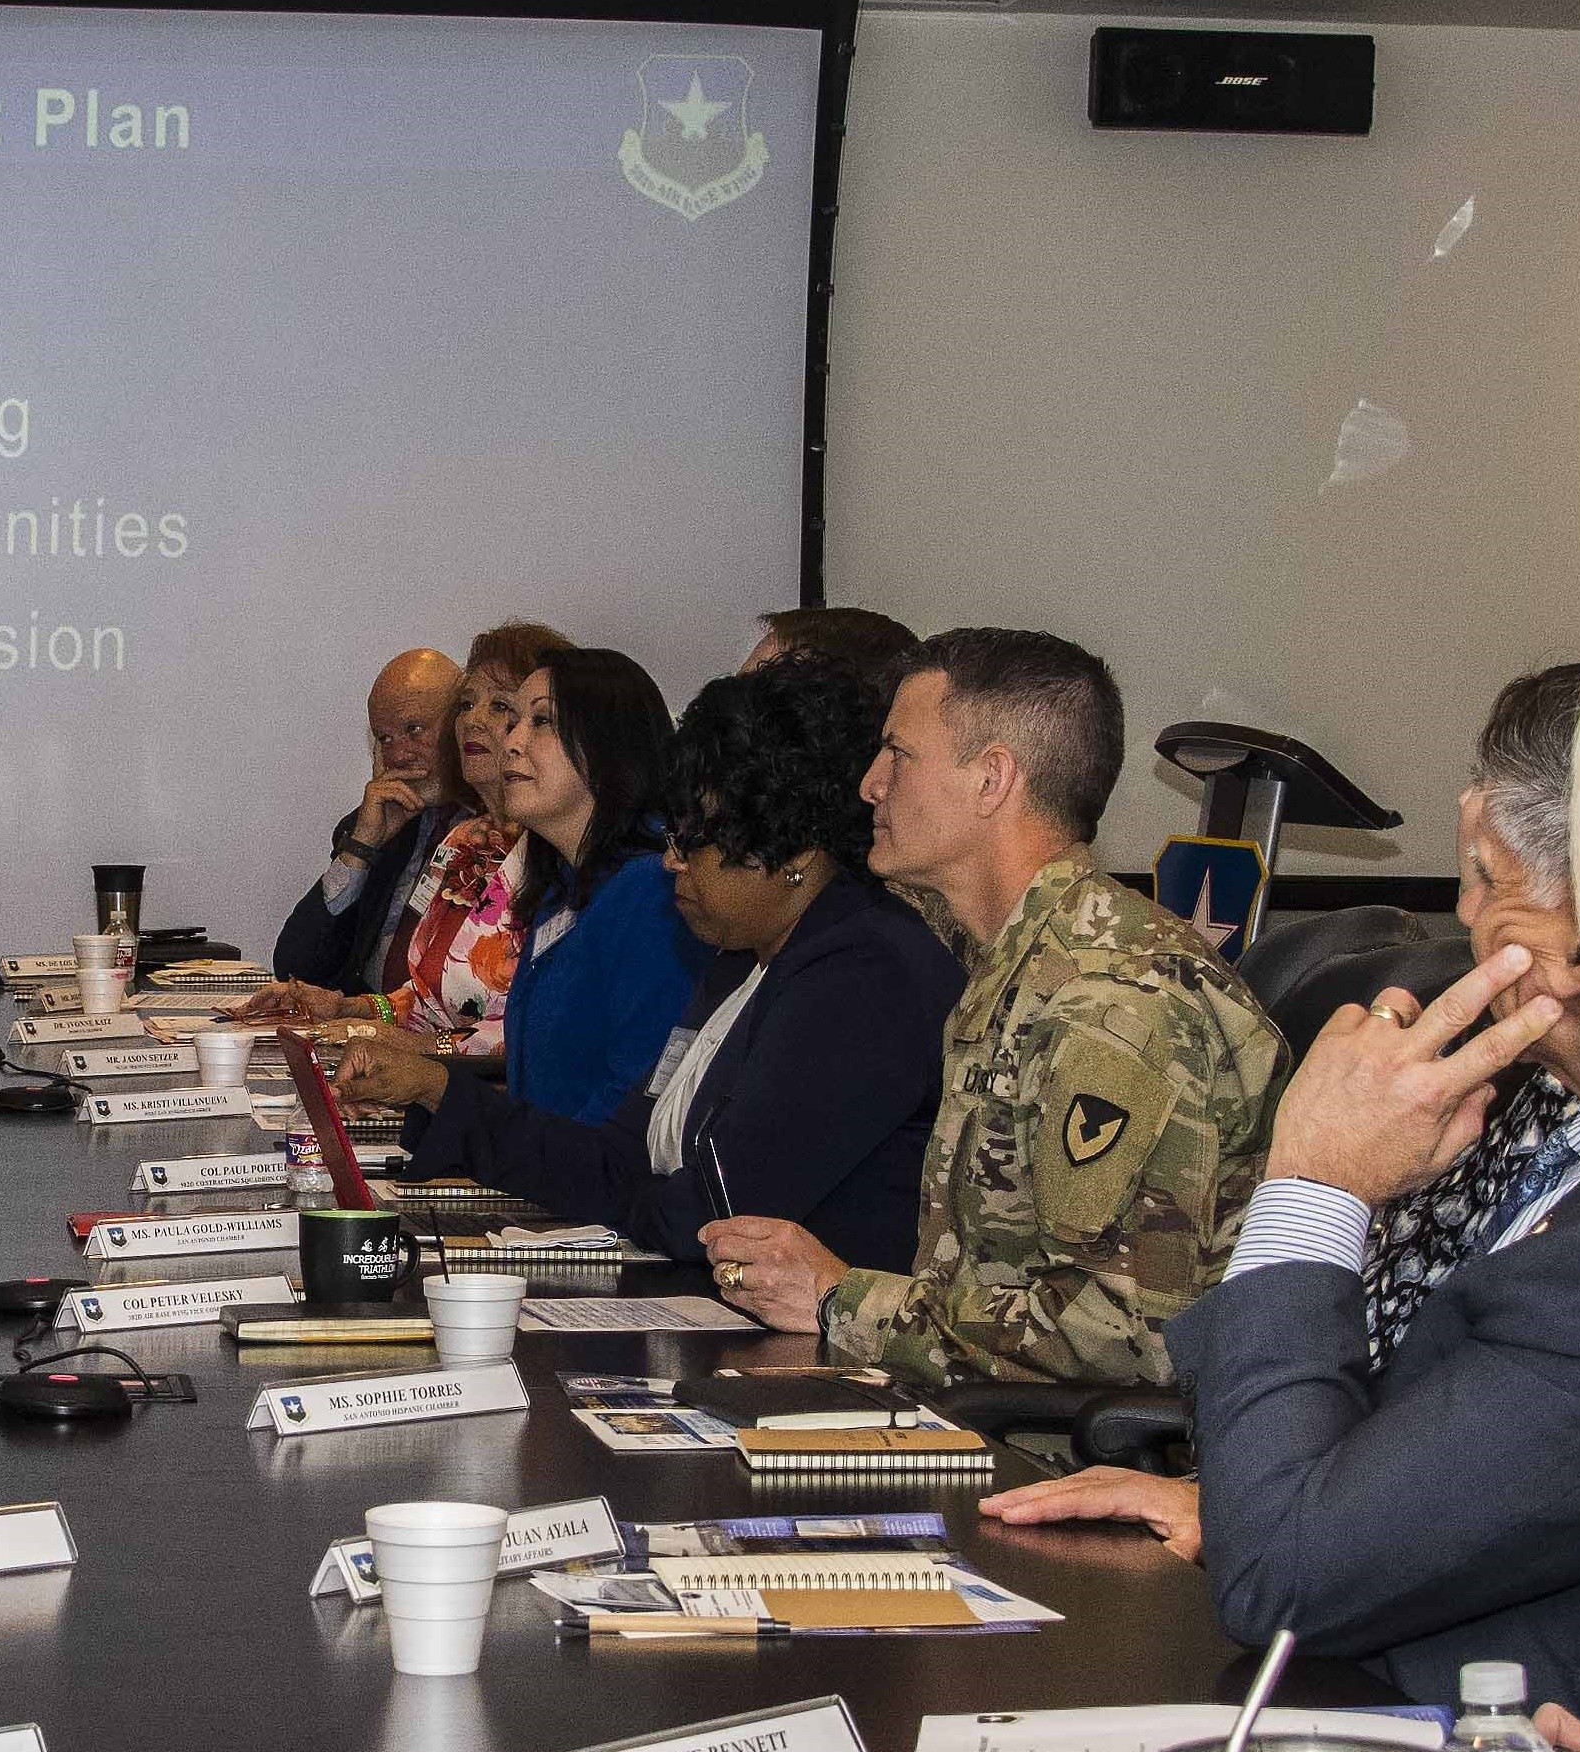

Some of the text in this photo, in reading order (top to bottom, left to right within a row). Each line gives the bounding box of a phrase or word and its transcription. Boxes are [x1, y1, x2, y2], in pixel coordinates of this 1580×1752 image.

[1214, 77, 1269, 86] BOSE
[34, 87, 193, 151] Plan
[122, 1054, 148, 1063] JASON
[149, 1053, 179, 1062] SETZER
[123, 1095, 228, 1111] MS. KRISTI VILLANUEVA
[200, 1165, 222, 1177] COL
[224, 1164, 249, 1176] PAUL
[132, 1218, 282, 1240] MS. PAULA GOLD-WILLIAMS
[123, 1289, 244, 1311] COL PETER VELESKY
[329, 1382, 463, 1410] MS. SOPHIE TORRES
[343, 1400, 460, 1422] SAN ANTONIO HISPANIC CHAMBER
[504, 1518, 590, 1550] JUAN AYALA
